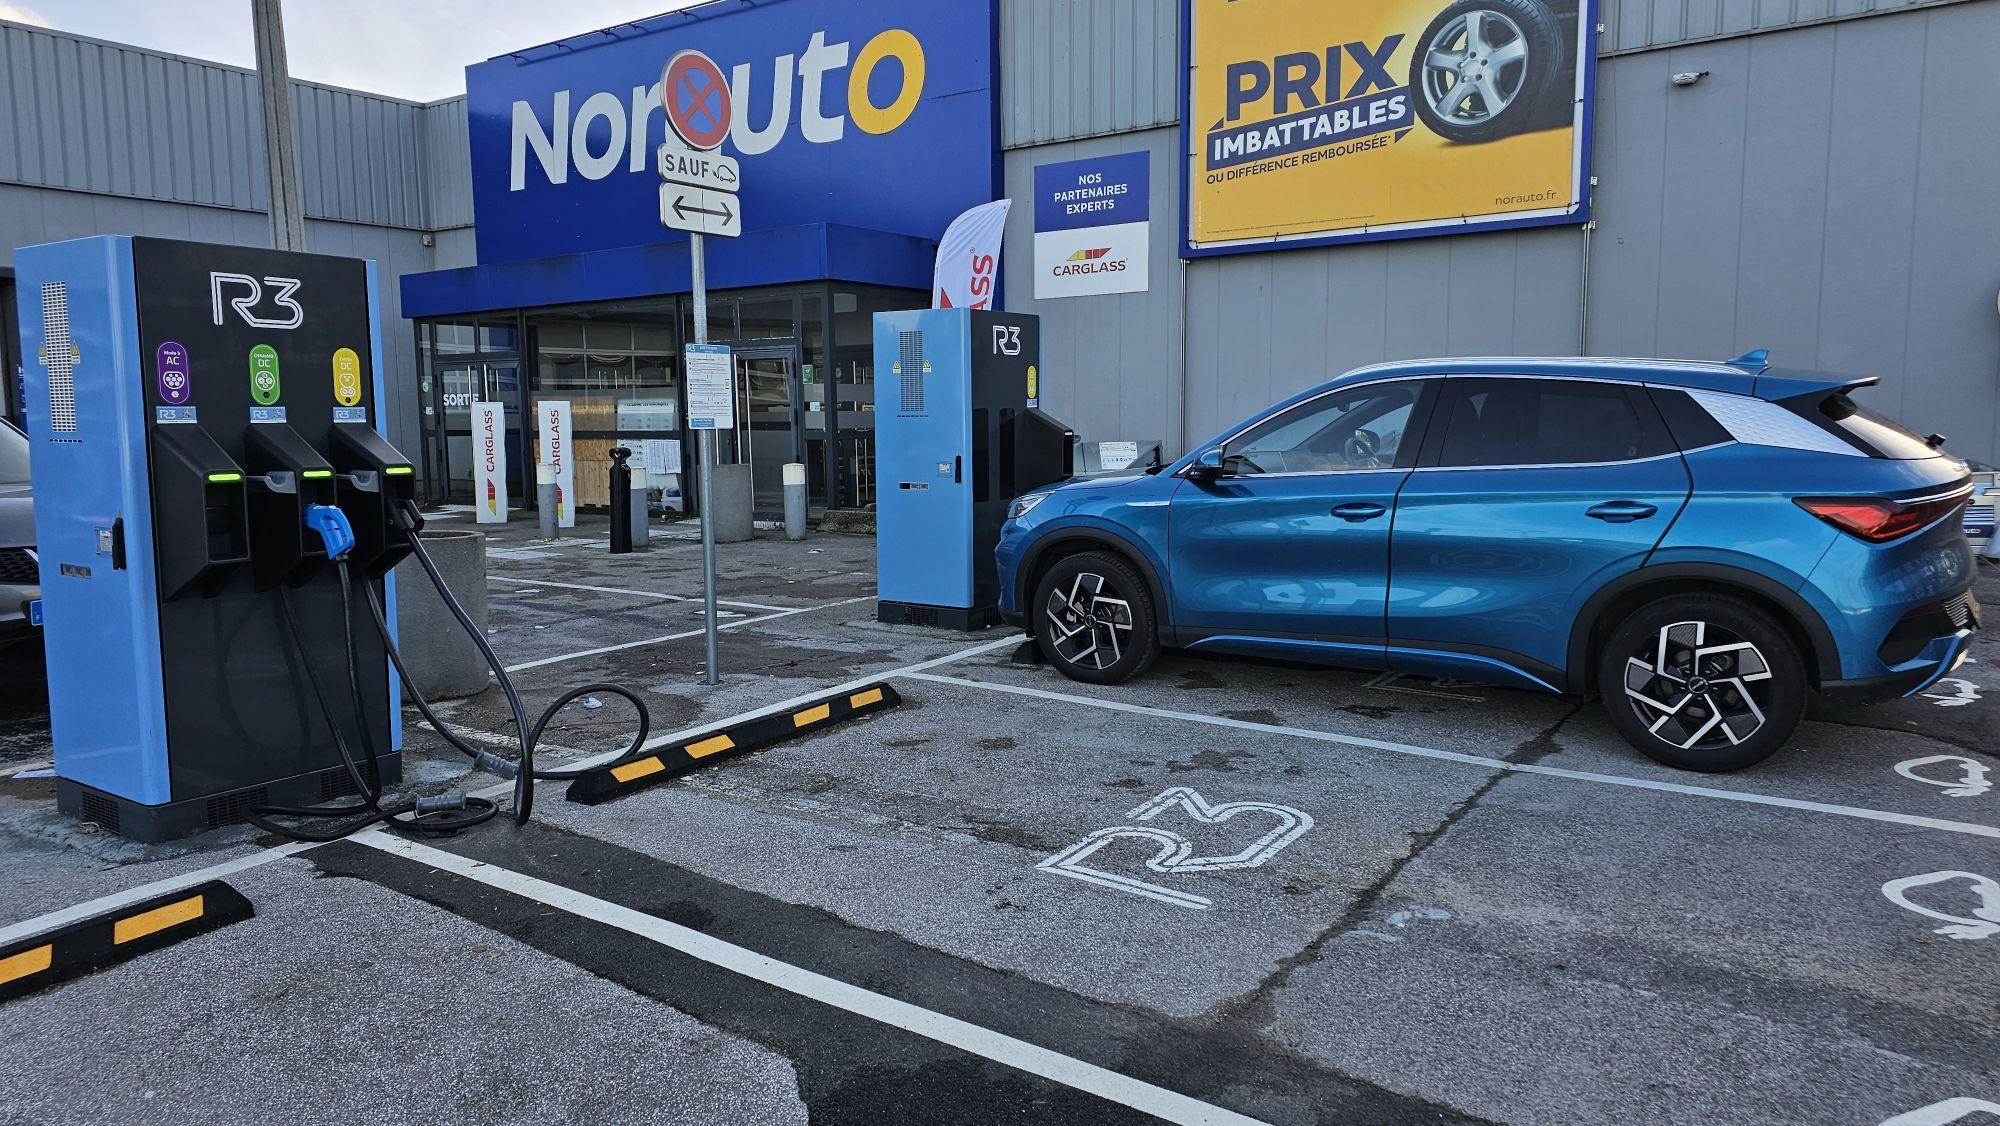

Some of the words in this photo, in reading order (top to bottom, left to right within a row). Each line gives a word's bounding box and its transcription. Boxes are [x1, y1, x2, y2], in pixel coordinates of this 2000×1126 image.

[1226, 33, 1406, 122] PRIX
[510, 29, 926, 192] Noruto
[1214, 95, 1406, 161] IMBATTABLES
[665, 153, 709, 178] SAUF
[1206, 171, 1224, 185] OU
[1227, 156, 1299, 180] DIFFÉRENCE
[1078, 173, 1102, 186] NOS
[1054, 183, 1128, 203] PARTENAIRES
[1495, 189, 1557, 205] norauto.fr
[1066, 199, 1115, 215] EXPERTS
[1053, 260, 1126, 277] CARGLASS
[210, 271, 304, 330] R3
[992, 325, 1021, 356] R3
[166, 356, 180, 365] AC
[258, 359, 271, 368] DC
[340, 362, 352, 370] DC
[443, 393, 479, 406] SORTE
[160, 409, 176, 419] R3
[253, 410, 268, 419] R3
[335, 410, 350, 419] R3
[484, 410, 495, 472] CARGLASS
